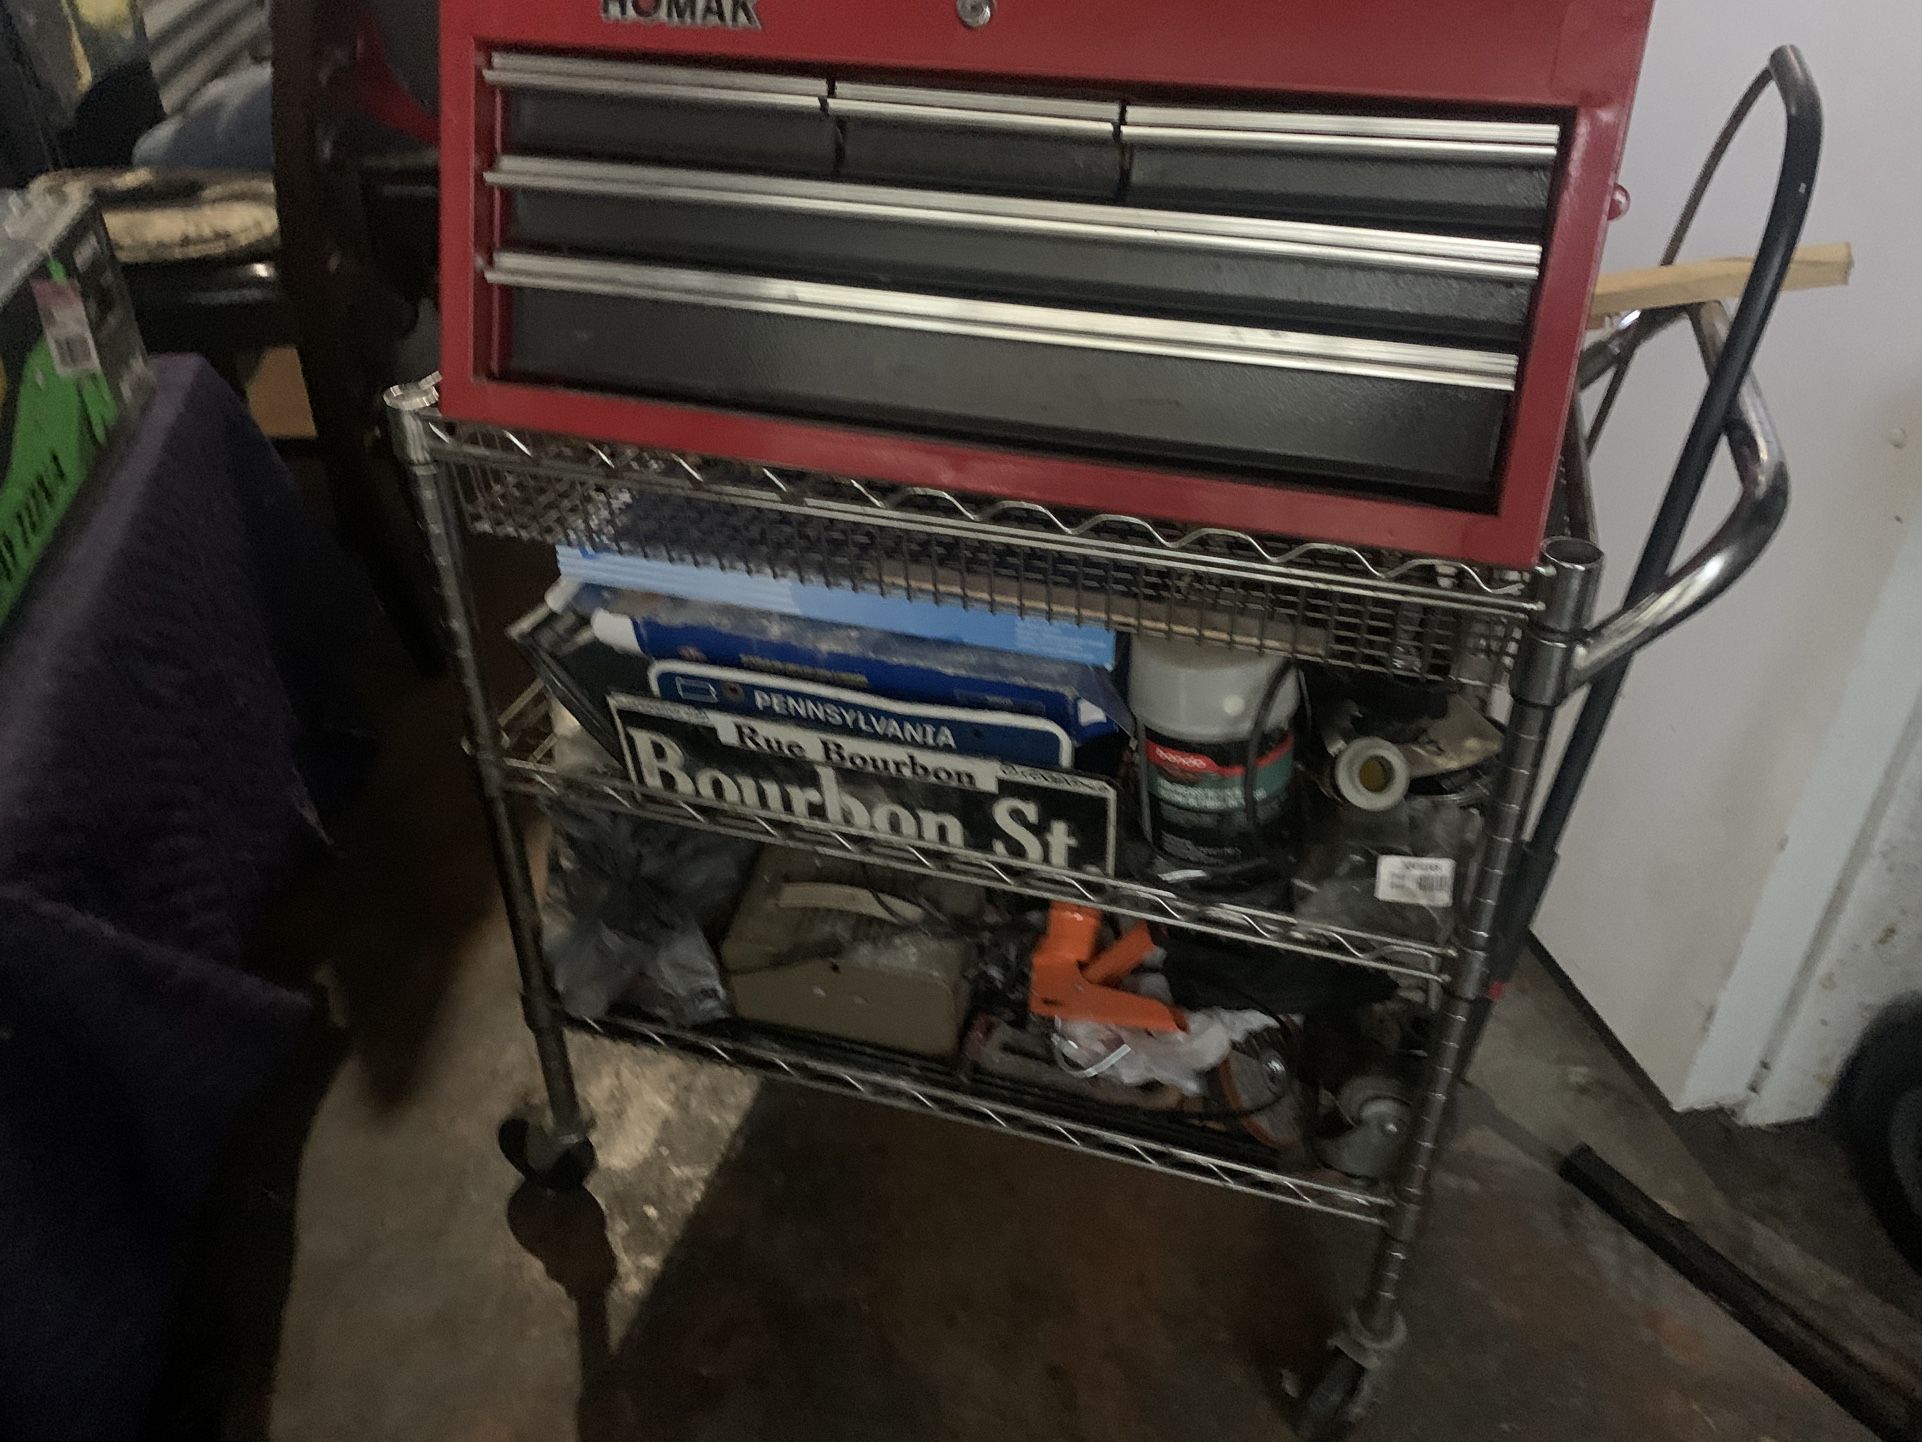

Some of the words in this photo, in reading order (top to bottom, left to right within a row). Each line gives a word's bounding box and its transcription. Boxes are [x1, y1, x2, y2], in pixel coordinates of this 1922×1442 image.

[754, 690, 957, 750] PENNSYLVANIA
[735, 721, 806, 757] Rue
[818, 736, 978, 787] Bourbon
[626, 727, 965, 848] Bourbon
